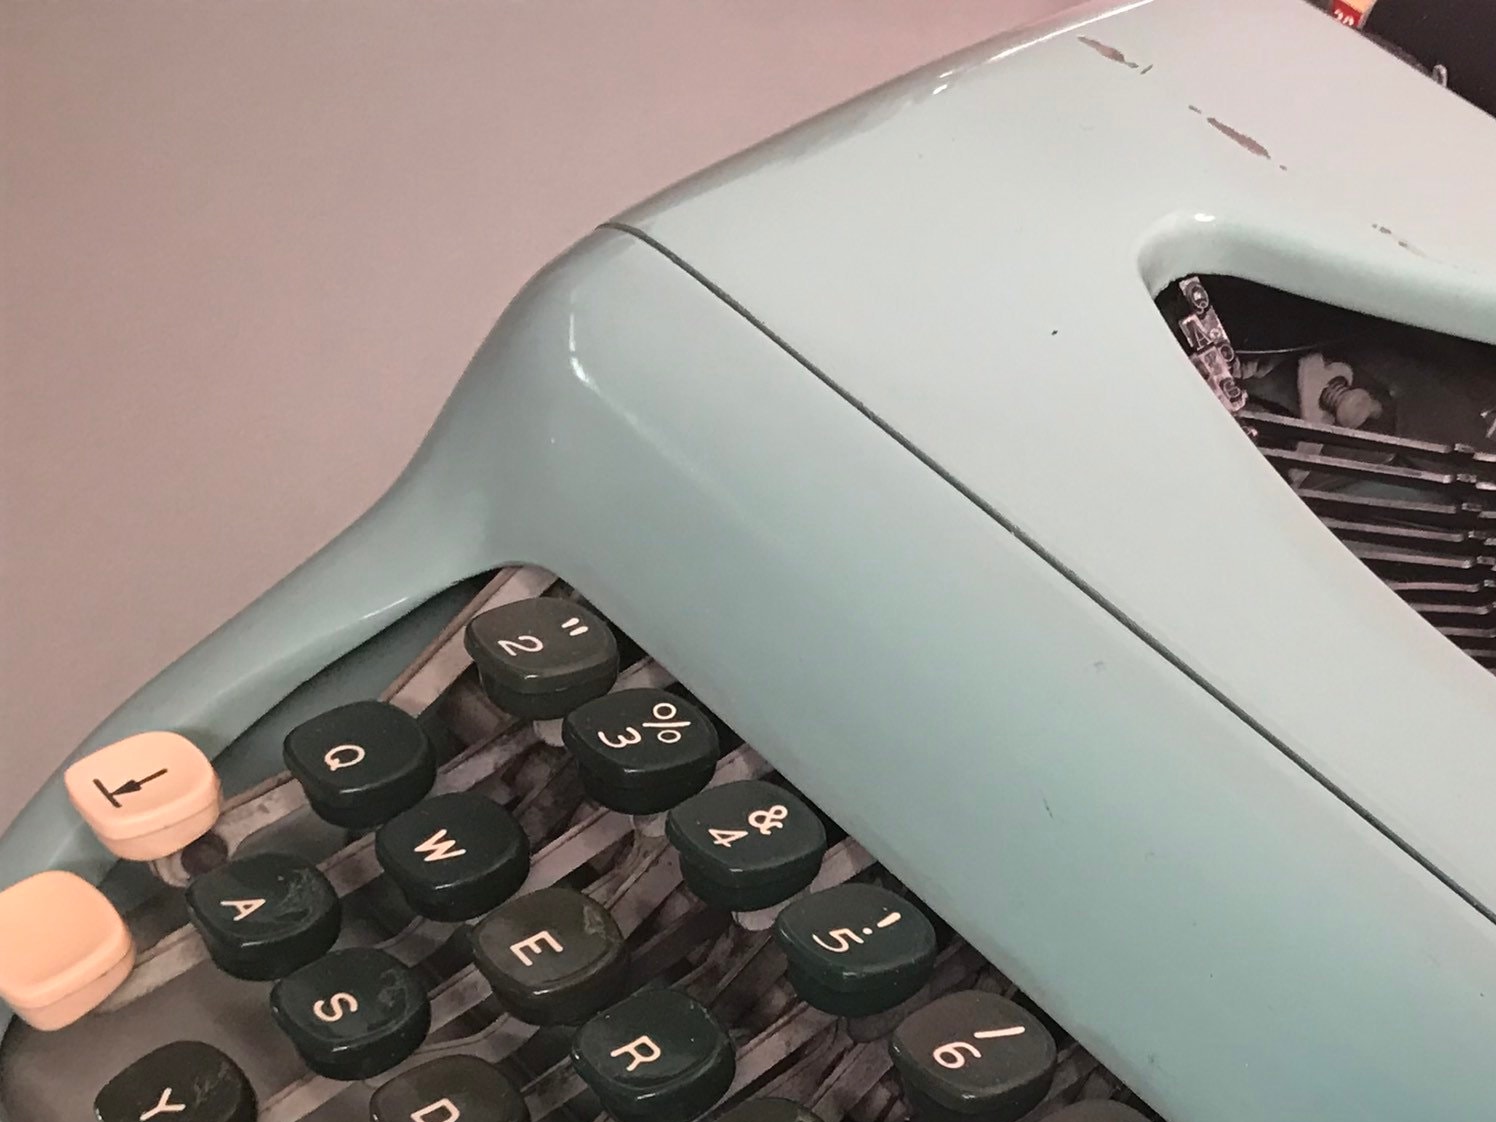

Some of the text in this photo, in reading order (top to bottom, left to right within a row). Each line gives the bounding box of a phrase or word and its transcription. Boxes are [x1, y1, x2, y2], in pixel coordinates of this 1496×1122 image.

[497, 635, 544, 656] 2
[597, 726, 642, 748] 3
[642, 702, 691, 744] %
[324, 744, 366, 771] Q
[748, 804, 788, 835] &
[414, 829, 467, 862] W
[708, 828, 749, 848] 4
[220, 898, 266, 921] A
[509, 930, 564, 967] E
[812, 928, 861, 953] 5
[313, 992, 358, 1022] S
[610, 1035, 661, 1072] R
[932, 1041, 982, 1069] 6
[139, 1087, 186, 1121] Y
